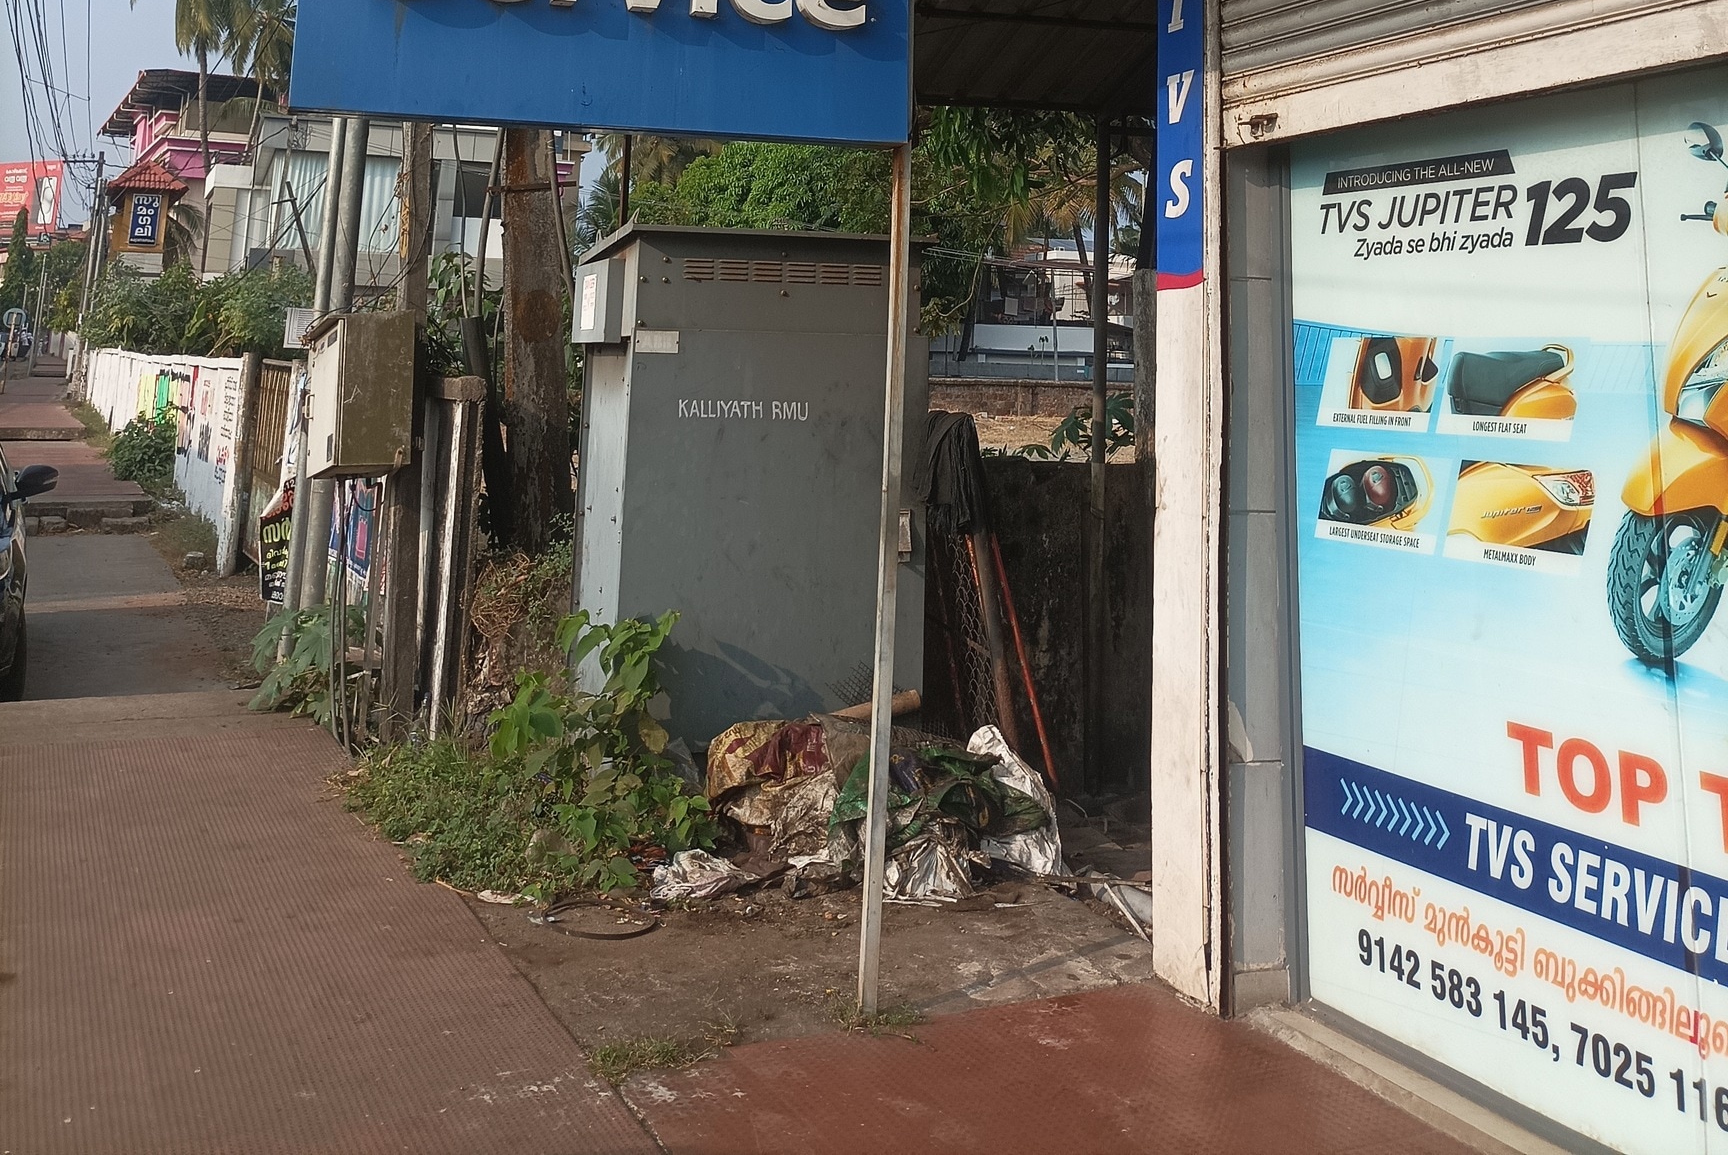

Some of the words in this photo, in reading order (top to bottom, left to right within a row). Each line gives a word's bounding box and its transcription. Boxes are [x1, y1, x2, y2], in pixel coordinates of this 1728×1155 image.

[1337, 168, 1411, 189] INTRODUCING
[1413, 165, 1436, 180] THE
[1438, 158, 1495, 177] ALL-NEW
[1319, 199, 1373, 235] TVS
[1378, 183, 1519, 230] JUPITER
[1524, 171, 1638, 247] 125
[1354, 233, 1403, 261] Zyada
[1406, 238, 1424, 254] se
[1428, 231, 1455, 253] bhi
[1459, 226, 1514, 255] zyada
[678, 399, 763, 419] KALLIYATH
[771, 400, 809, 422] RMU
[1333, 413, 1356, 424] EXTERNAL
[1356, 414, 1368, 425] FUEL
[1368, 415, 1387, 425] FILLING
[1388, 415, 1394, 426] IN
[1394, 416, 1411, 427] FRONT
[1472, 420, 1497, 433] LONGEST
[1498, 422, 1511, 433] FLAT
[1512, 423, 1527, 434] SEAT
[1329, 526, 1350, 538] LARGEST
[1350, 528, 1379, 543] UNDERSEAT
[1379, 533, 1402, 546] STORAGE
[1403, 536, 1420, 548] SPACE
[1483, 548, 1518, 564] METALMAXX
[1519, 554, 1536, 567] BODY
[1506, 720, 1668, 827] TOP
[1465, 812, 1536, 891] TVS
[1332, 864, 1421, 924] സർവ്വീസ്
[1424, 902, 1526, 978] മുൻകൂട്ടി
[1358, 928, 1421, 990] 9142
[1430, 959, 1483, 1018] 583
[1493, 989, 1560, 1062] 145,
[1570, 1022, 1656, 1099] 7025
